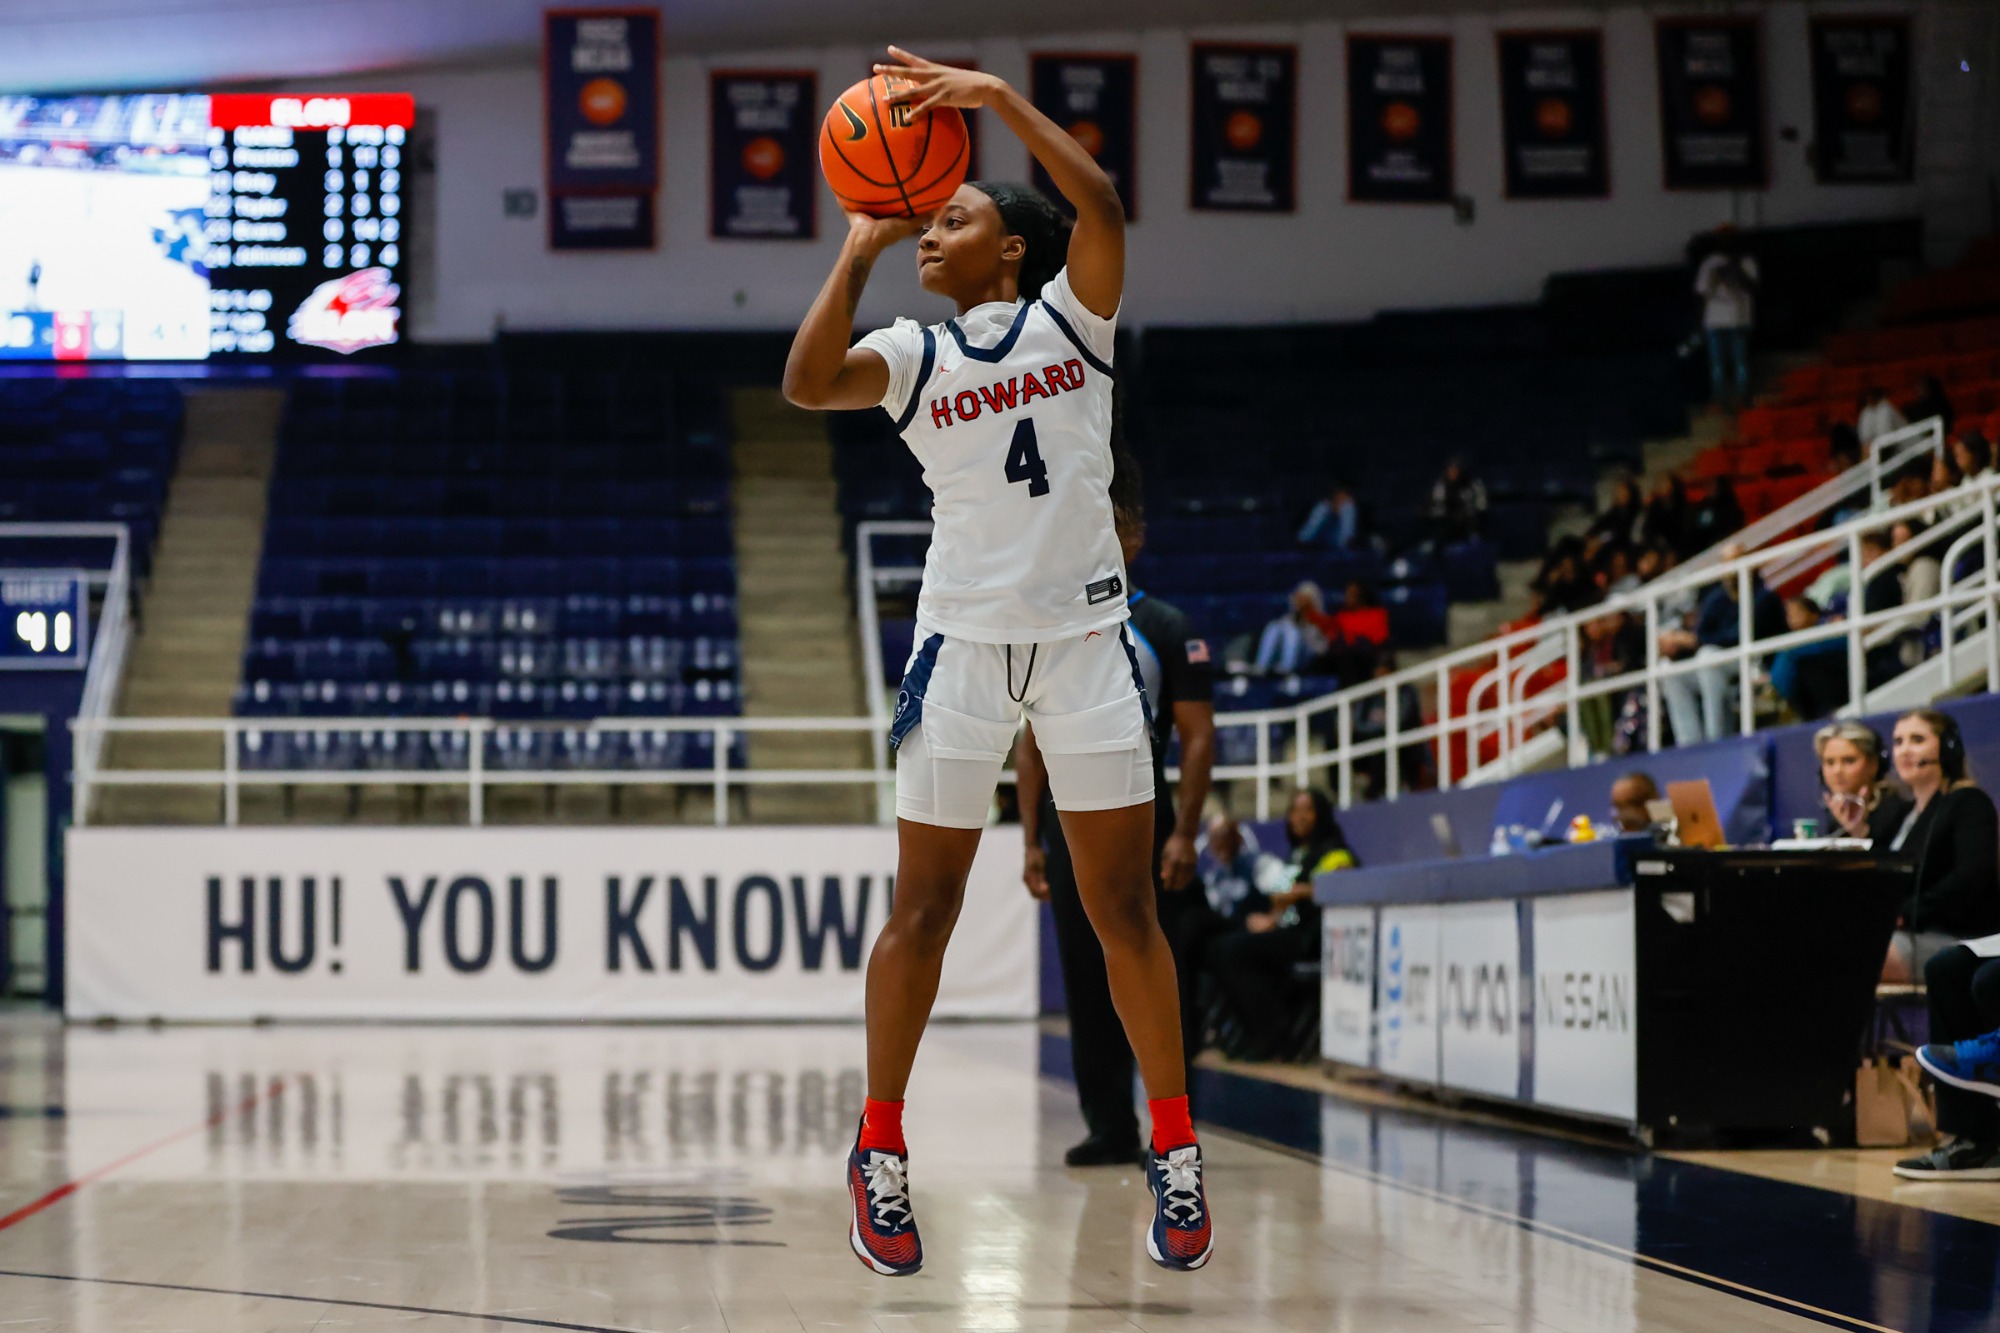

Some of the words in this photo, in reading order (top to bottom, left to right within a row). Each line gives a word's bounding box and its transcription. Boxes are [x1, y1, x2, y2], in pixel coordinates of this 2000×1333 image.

[931, 358, 1086, 429] HOWARD
[1004, 417, 1050, 498] 4
[1112, 581, 1119, 591] S
[207, 876, 343, 974] HU!
[388, 876, 559, 974] YOU
